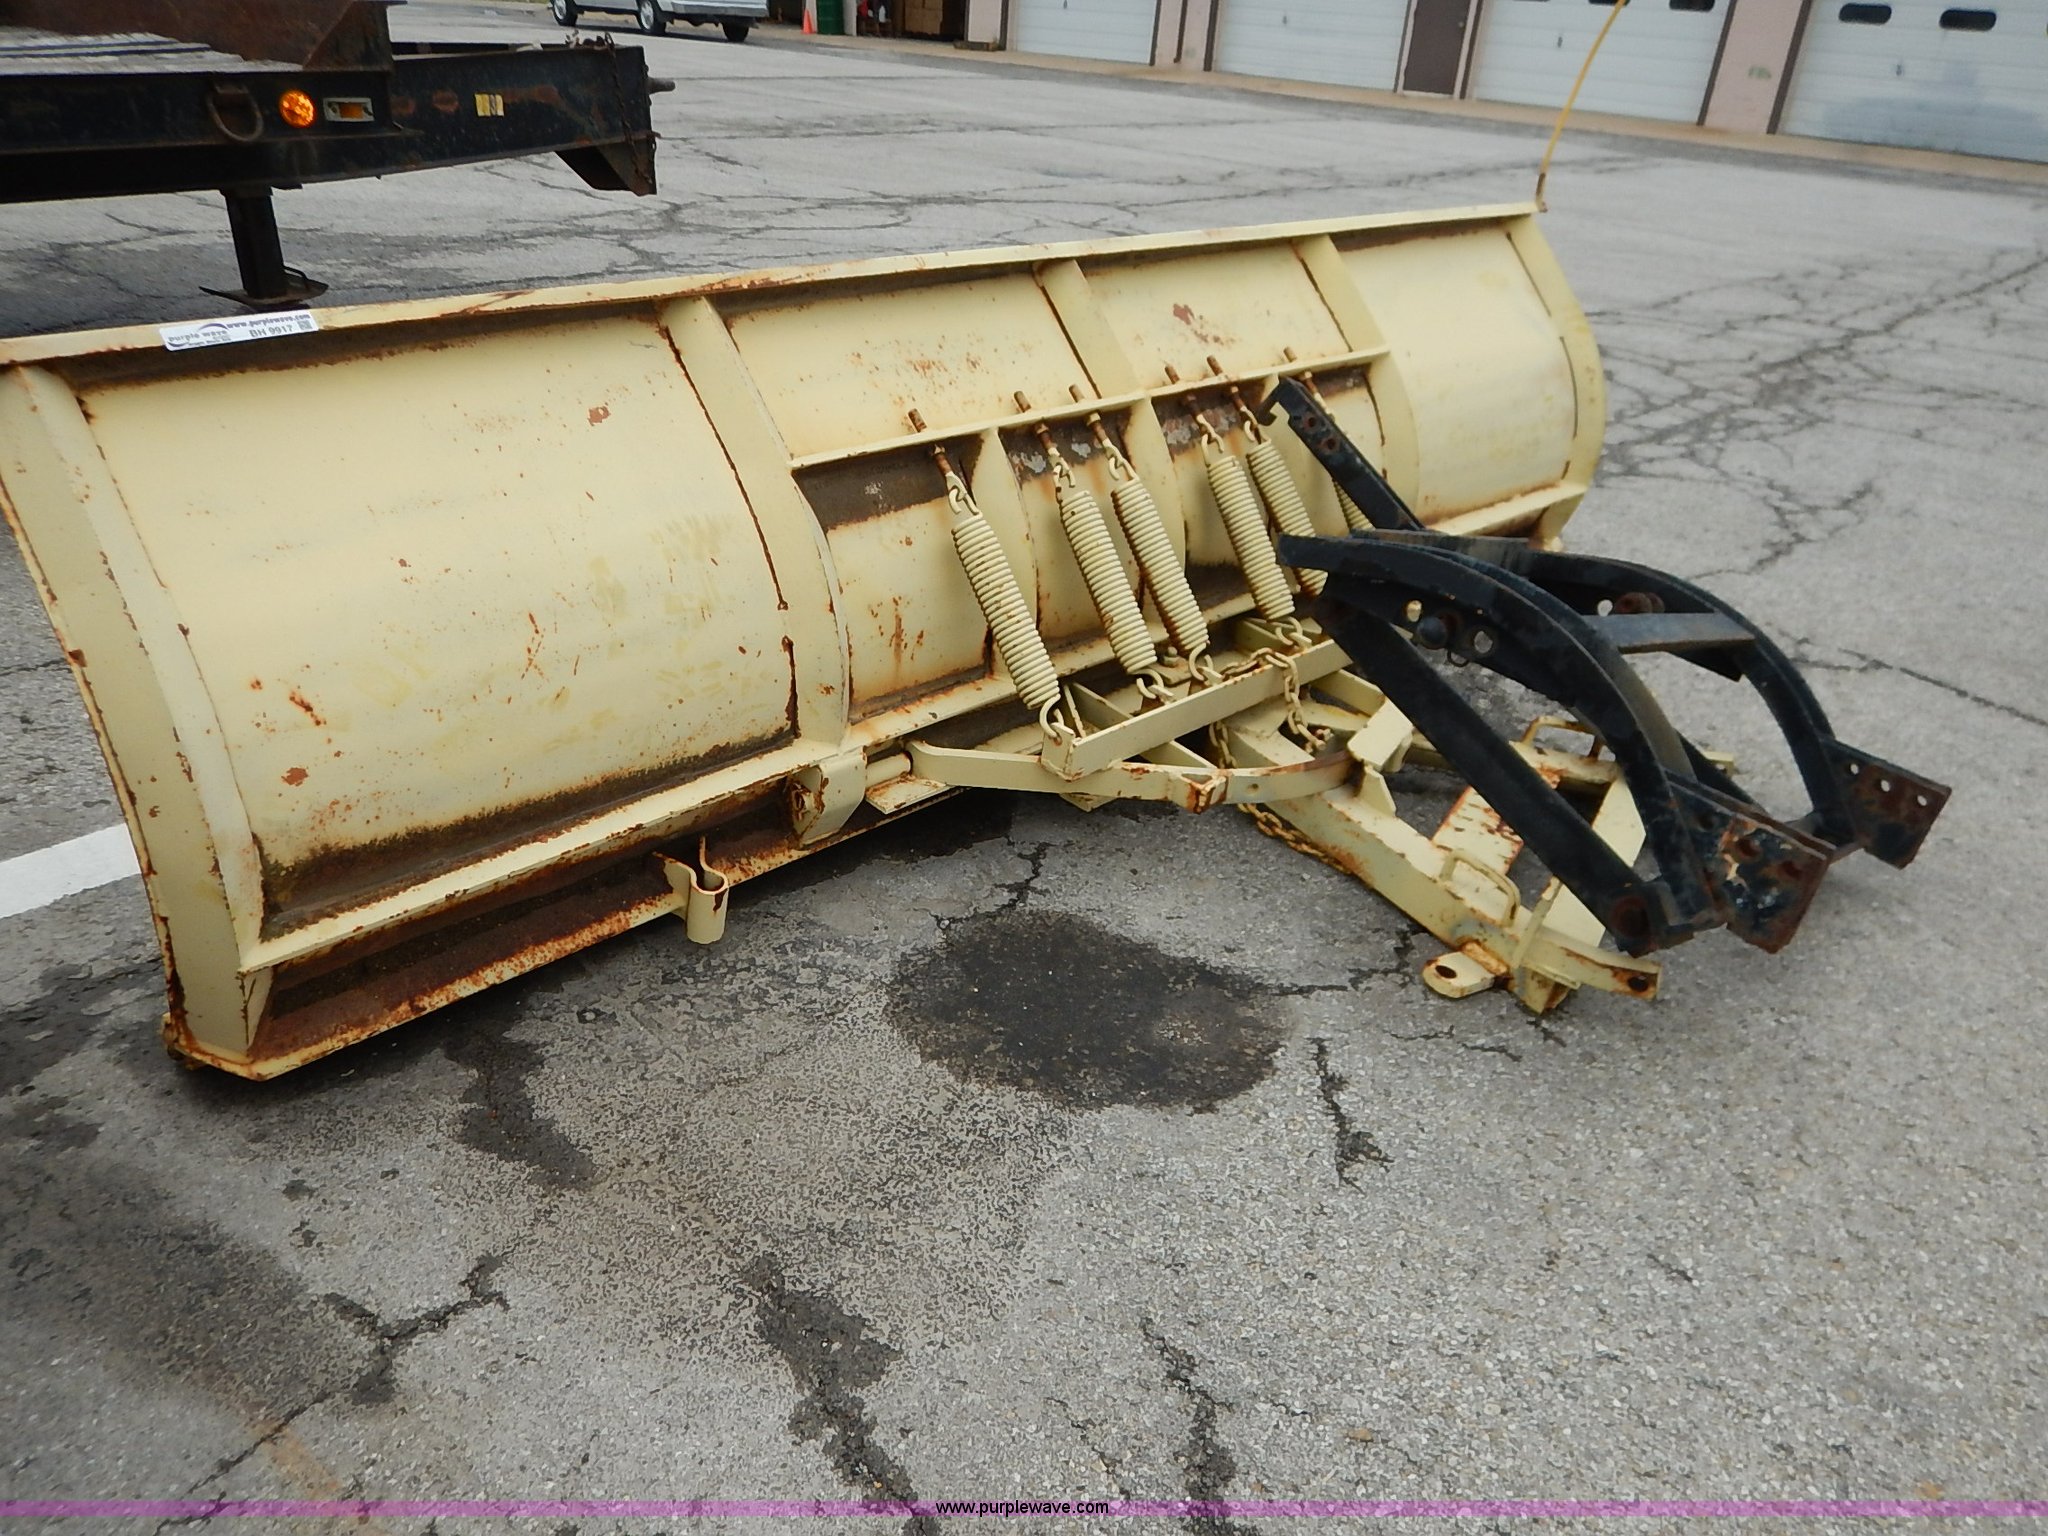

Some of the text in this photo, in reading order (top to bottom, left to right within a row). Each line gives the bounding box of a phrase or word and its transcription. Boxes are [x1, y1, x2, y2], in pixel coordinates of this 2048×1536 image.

[226, 314, 311, 329] www.purplewave.com
[168, 332, 200, 344] purple
[201, 329, 228, 338] wave
[269, 325, 293, 336] 9917
